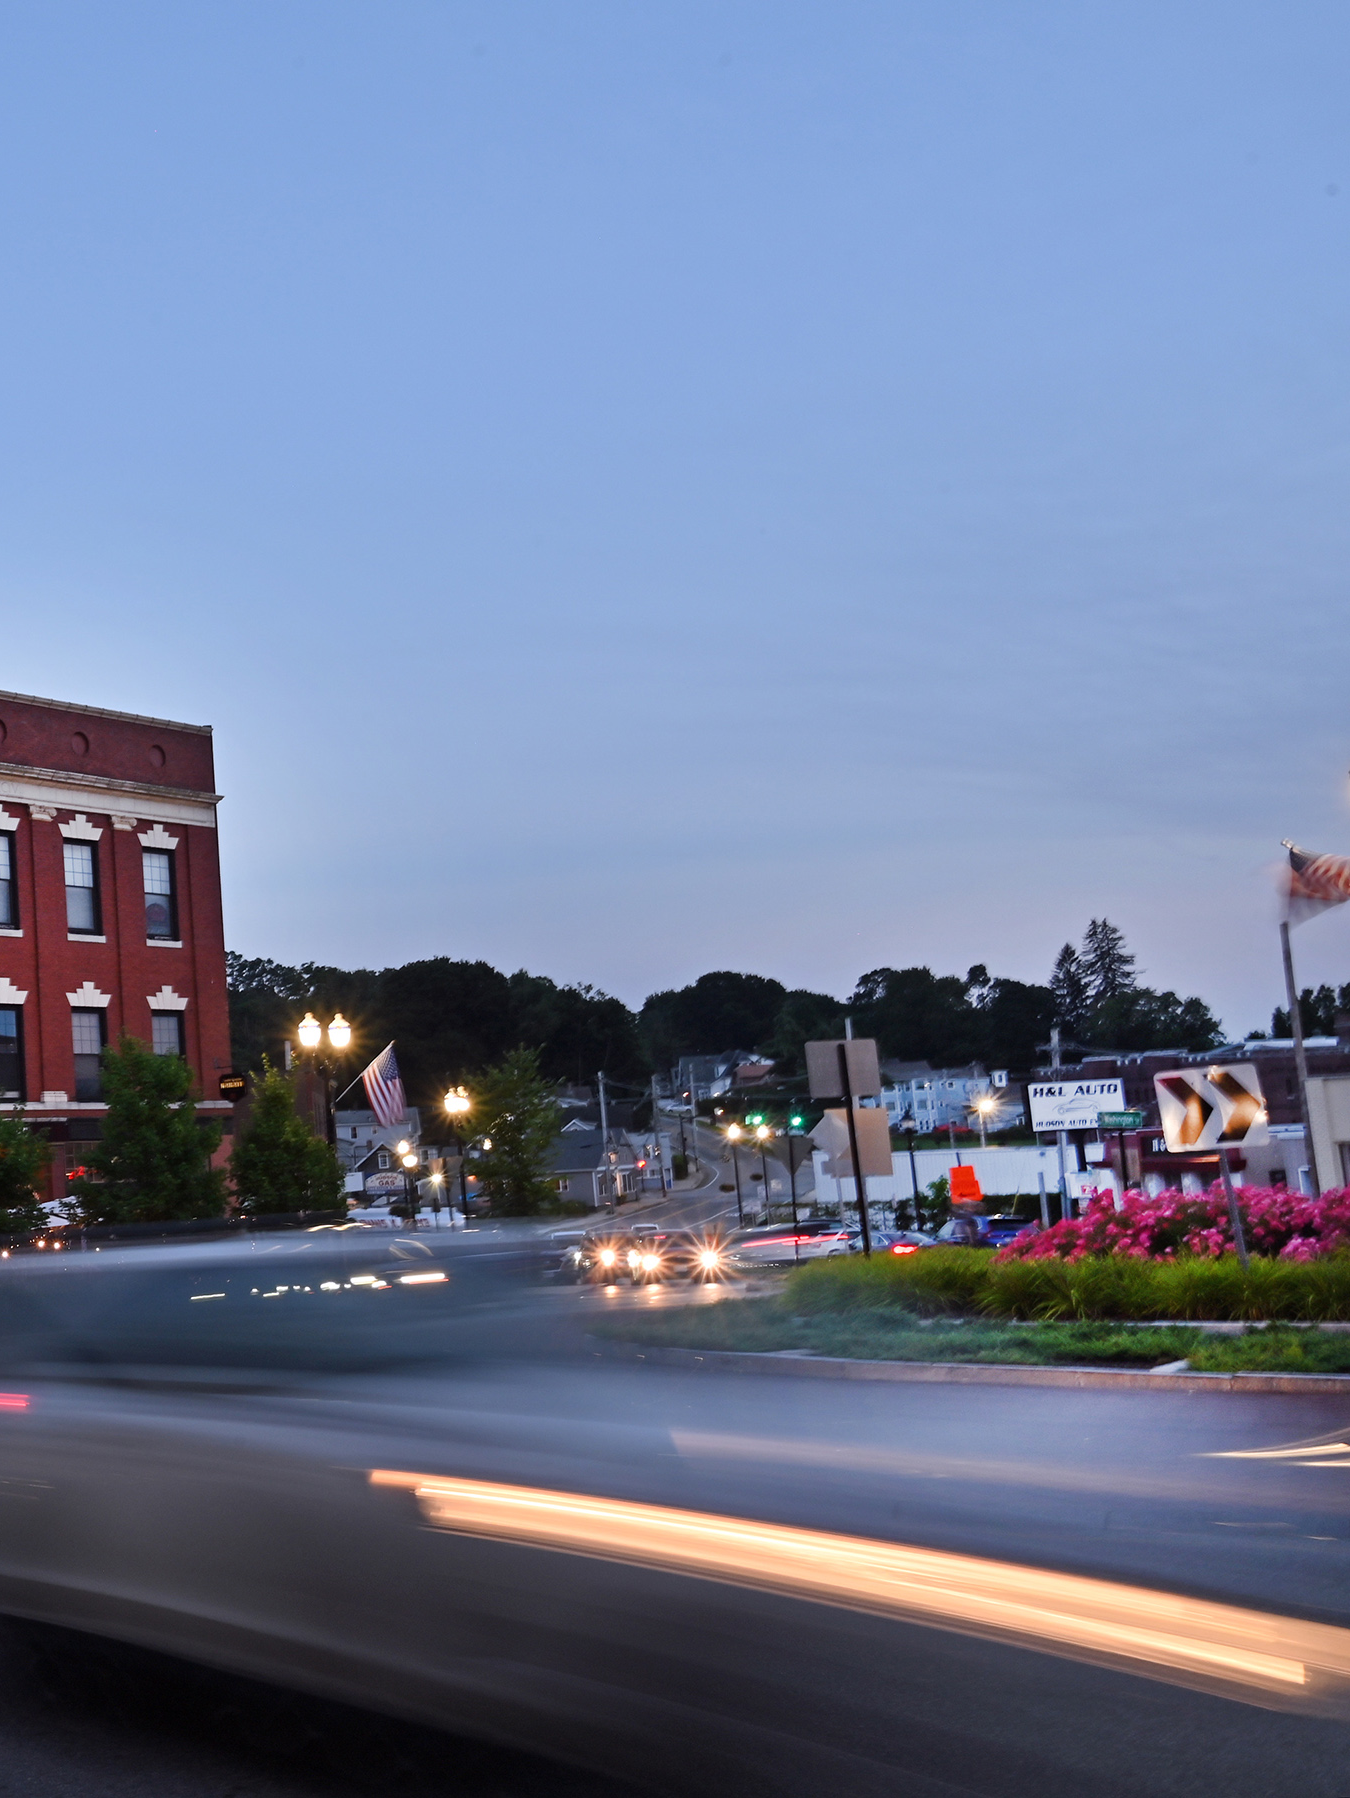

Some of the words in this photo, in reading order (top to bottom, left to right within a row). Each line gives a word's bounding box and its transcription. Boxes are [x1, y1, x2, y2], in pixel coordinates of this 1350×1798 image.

[1033, 1087, 1066, 1098] H&L
[1074, 1084, 1118, 1096] AUTO
[1036, 1120, 1065, 1128] HUDSON
[1068, 1119, 1087, 1127] AUTO
